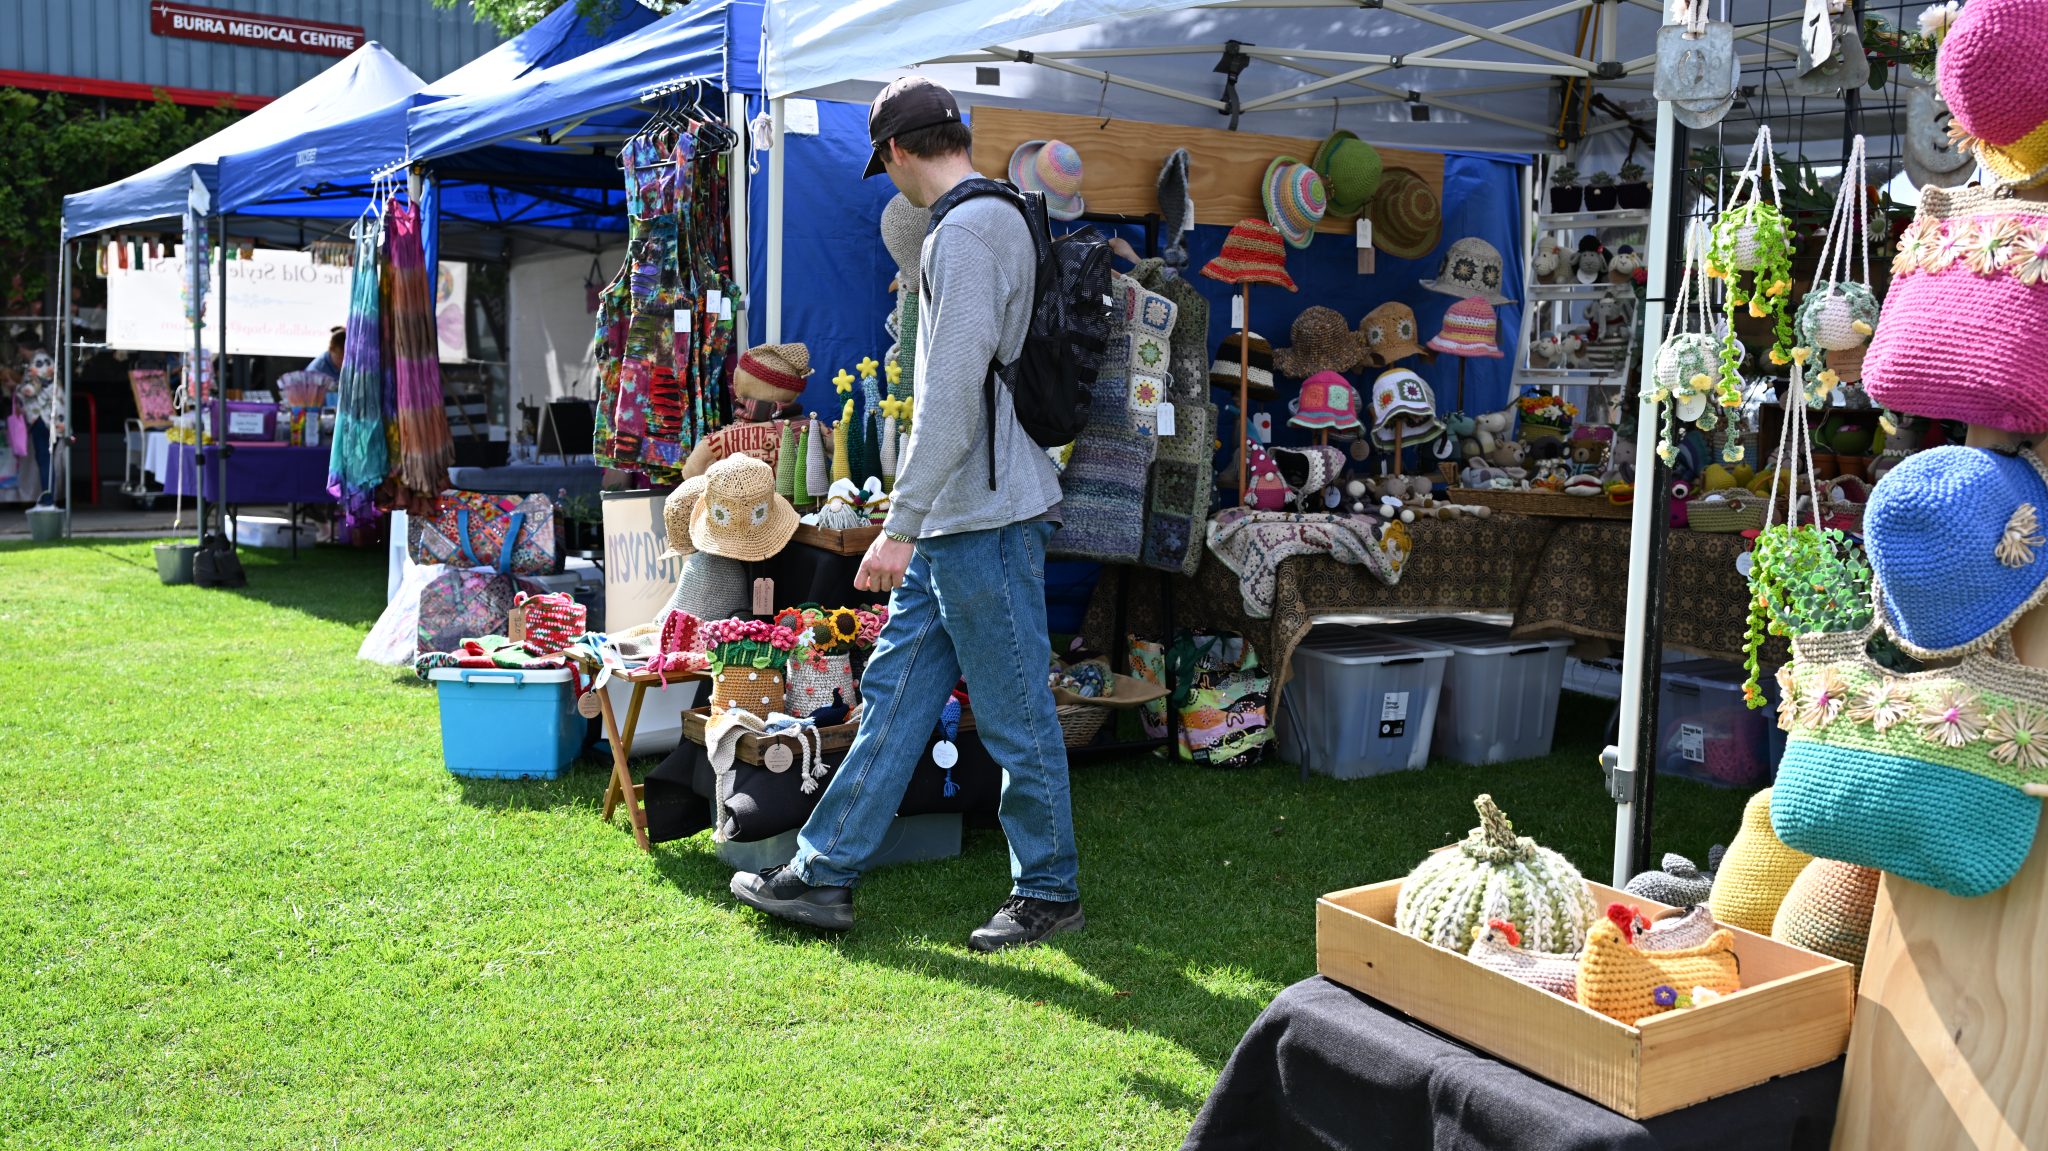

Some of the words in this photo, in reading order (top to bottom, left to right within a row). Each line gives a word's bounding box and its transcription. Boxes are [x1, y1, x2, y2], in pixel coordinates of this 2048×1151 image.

[173, 15, 225, 34] BURRA
[229, 22, 296, 42] MEDICAL
[301, 31, 355, 49] CENTRE
